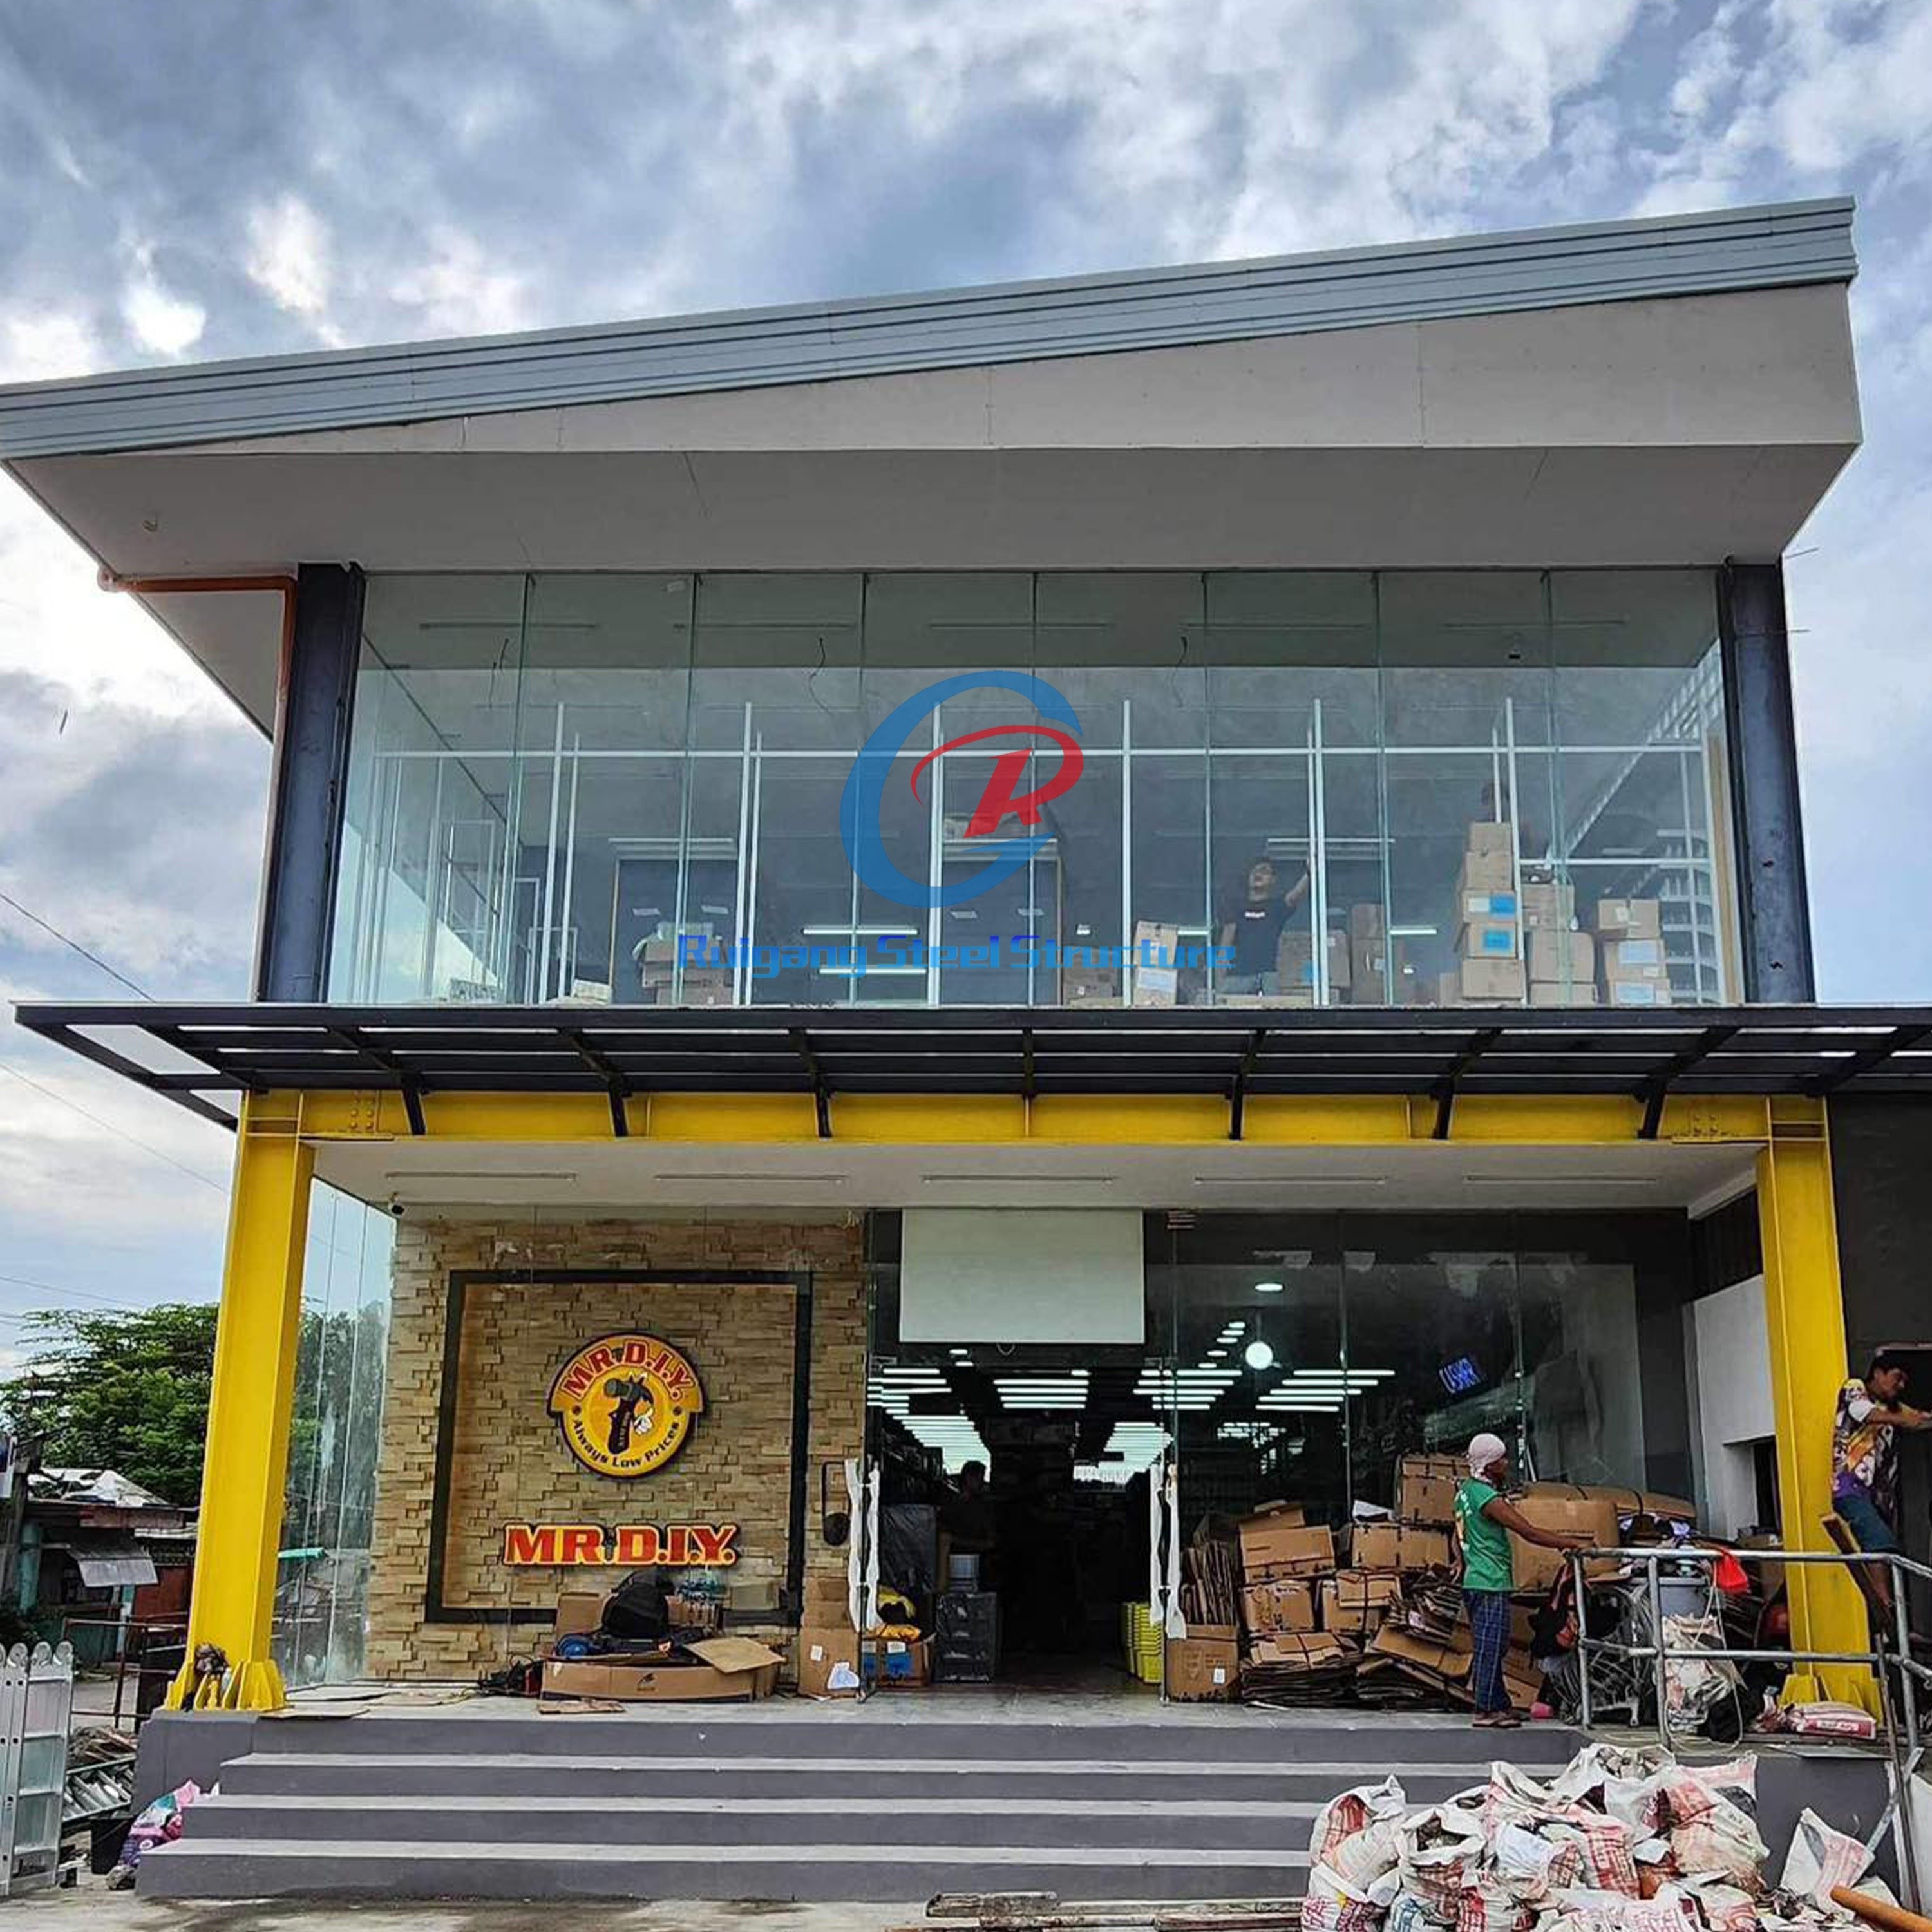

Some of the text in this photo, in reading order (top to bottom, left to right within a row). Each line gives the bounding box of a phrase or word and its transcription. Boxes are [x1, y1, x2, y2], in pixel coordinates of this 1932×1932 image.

[573, 1419, 609, 1463] Always
[612, 1456, 642, 1467] Low
[645, 1421, 680, 1461] Prices
